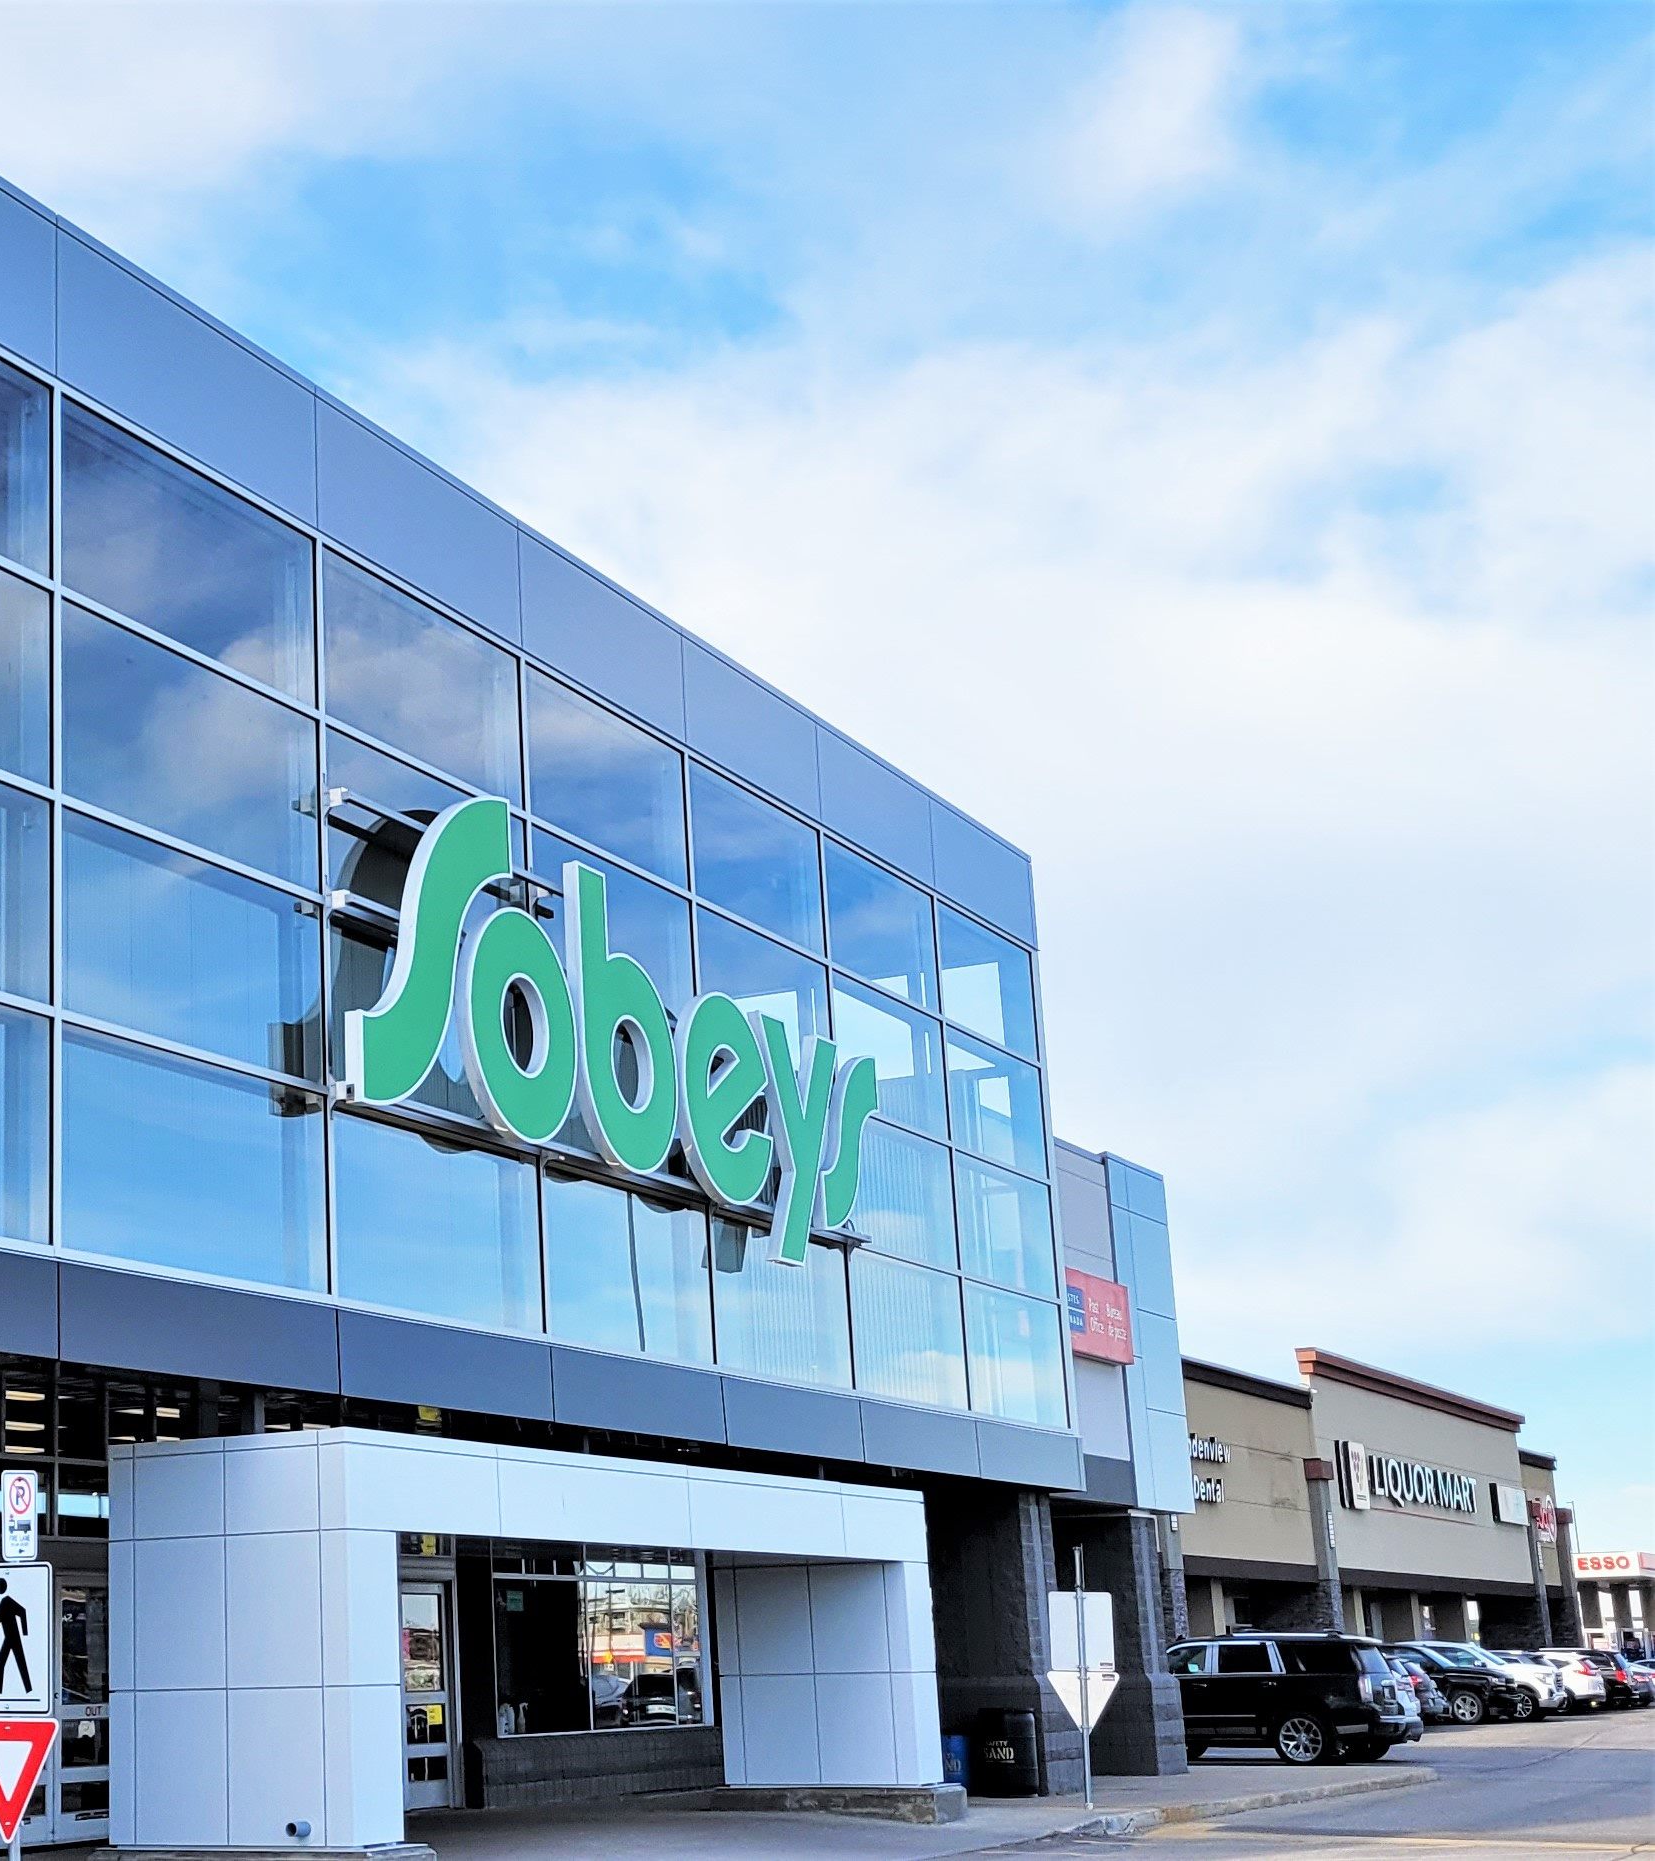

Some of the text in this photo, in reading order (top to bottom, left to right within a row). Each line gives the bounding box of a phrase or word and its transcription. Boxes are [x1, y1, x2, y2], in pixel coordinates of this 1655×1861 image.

[345, 796, 878, 1266] Sobeys
[1194, 1474, 1225, 1503] Dental
[1372, 1455, 1477, 1513] LIQUOR MART
[1577, 1556, 1631, 1571] ESSO
[85, 1706, 103, 1717] OUT
[984, 1747, 1015, 1760] SAND
